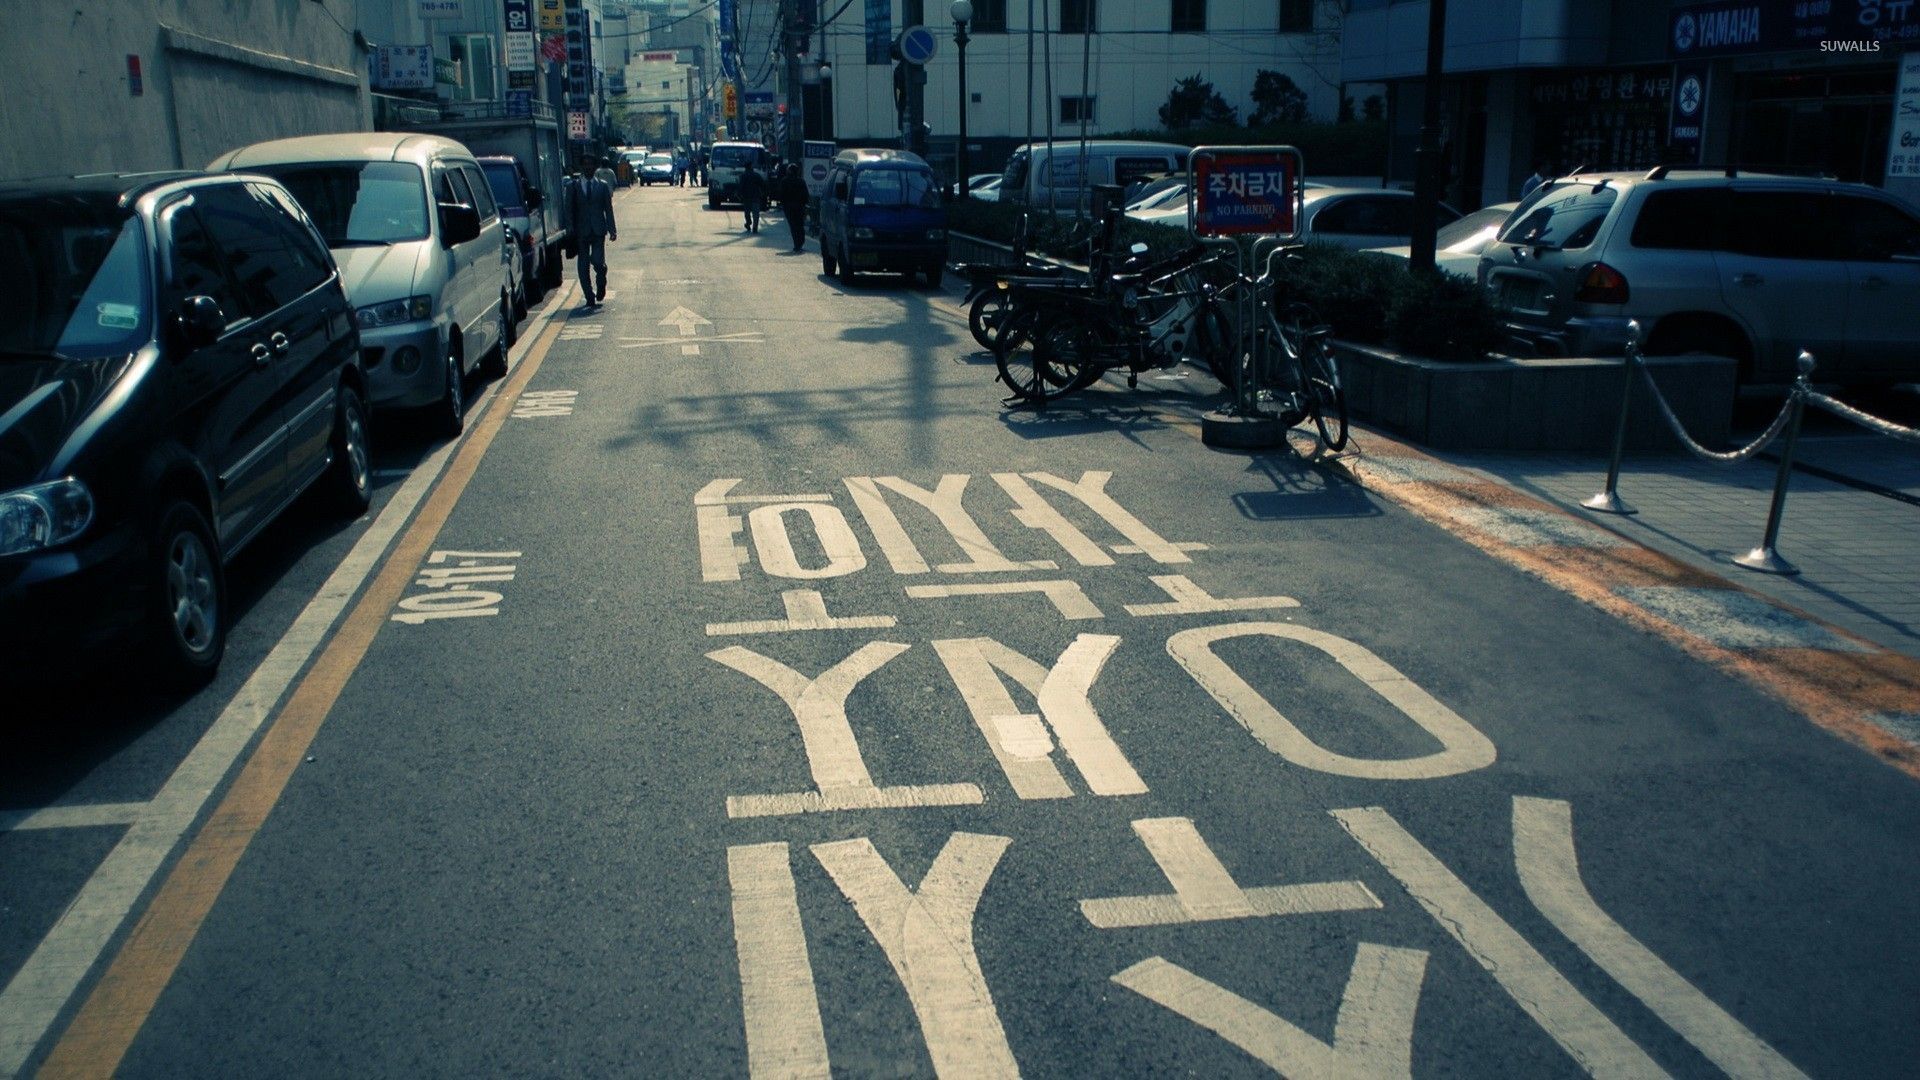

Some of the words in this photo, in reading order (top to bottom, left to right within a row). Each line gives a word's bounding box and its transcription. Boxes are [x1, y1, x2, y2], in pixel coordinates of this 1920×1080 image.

[1699, 7, 1760, 47] YAMAHA
[1209, 171, 1283, 198] 주차금지
[1217, 205, 1231, 216] NO
[1233, 203, 1276, 216] PARKING
